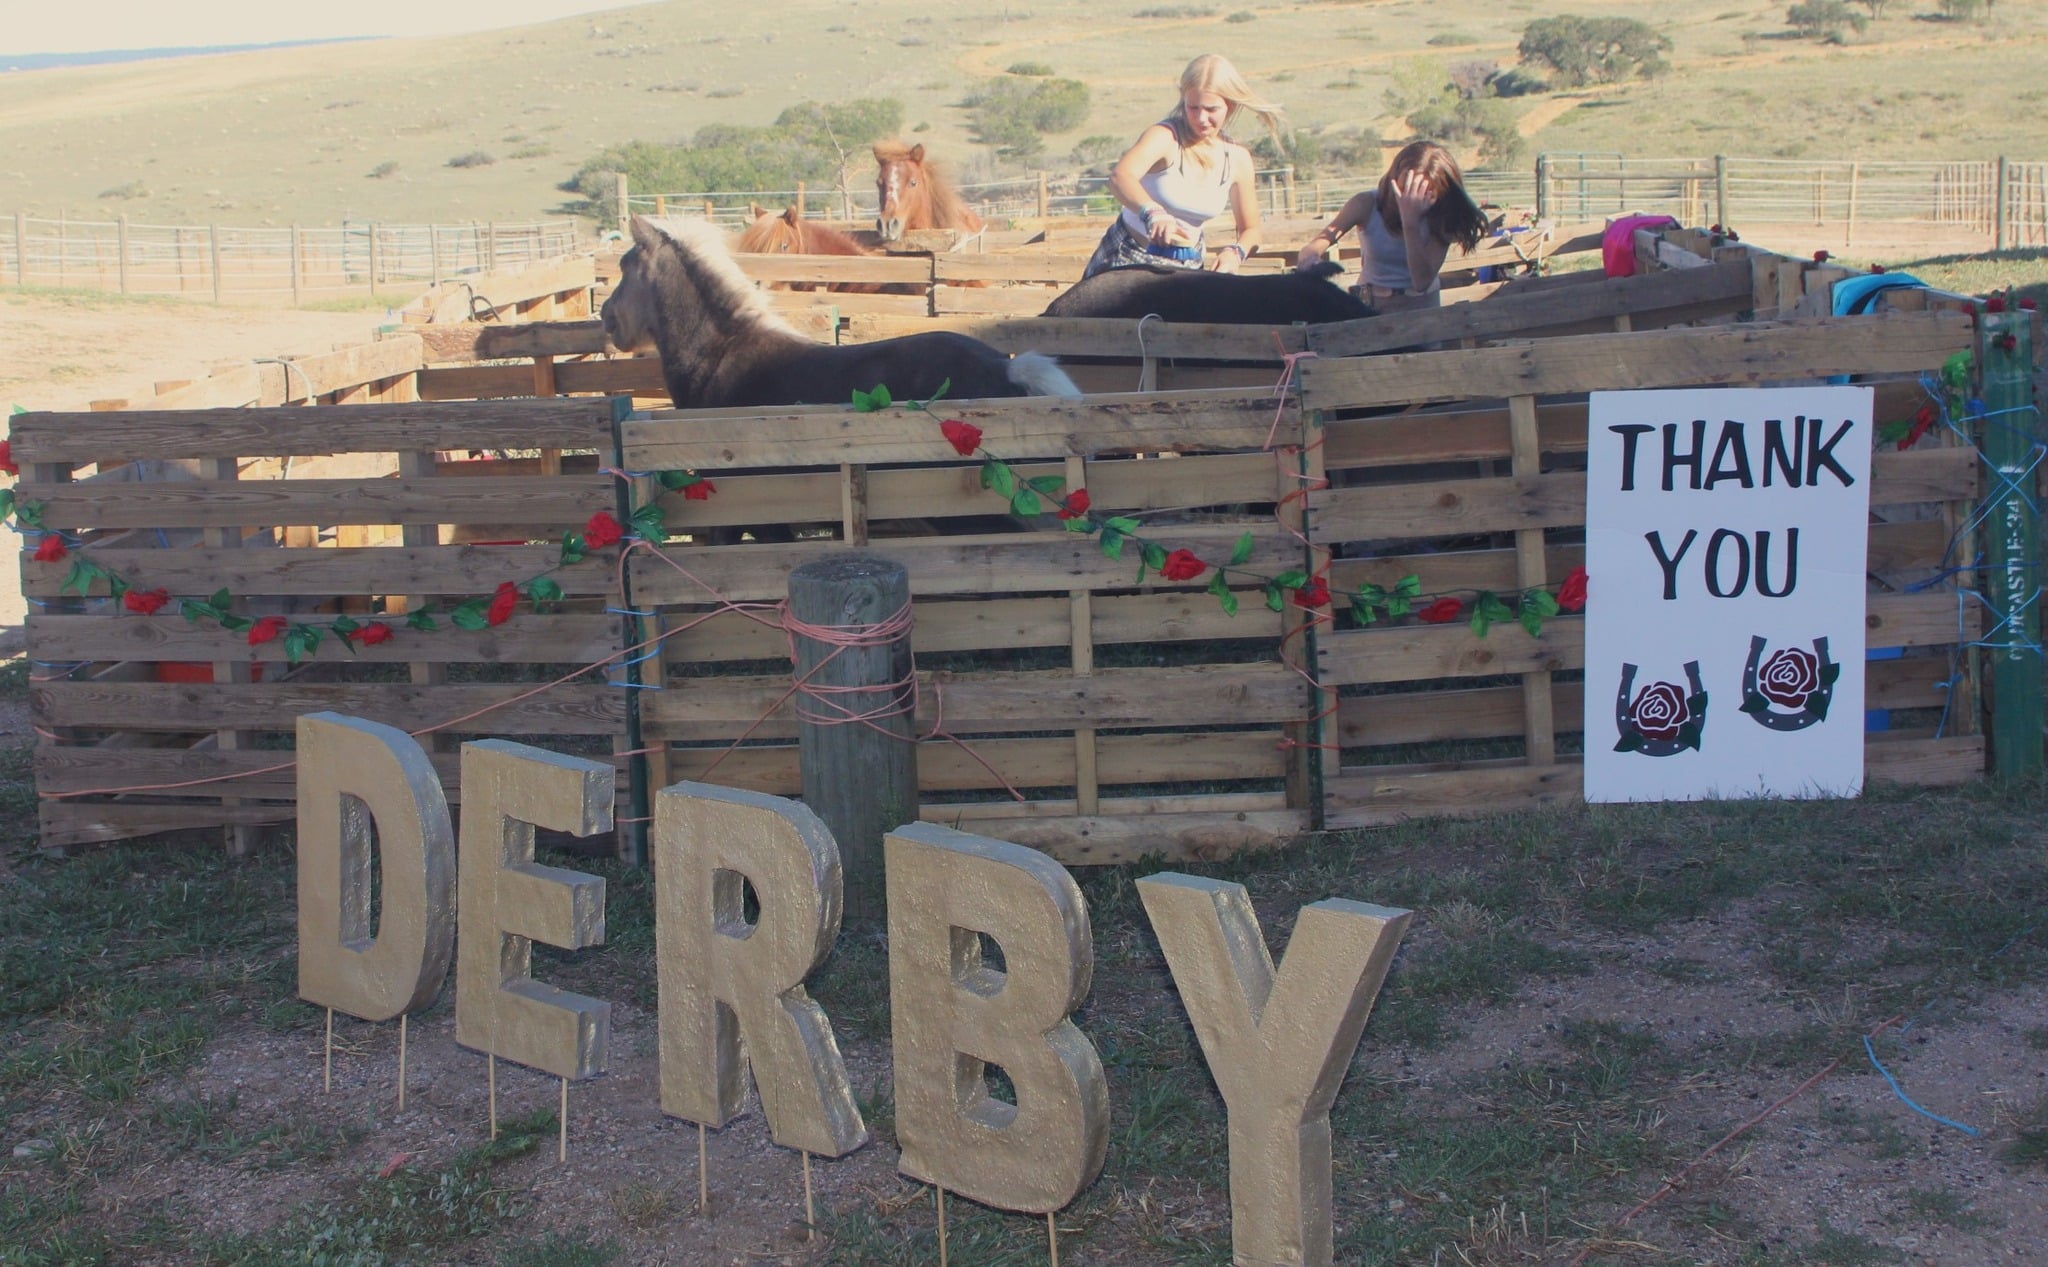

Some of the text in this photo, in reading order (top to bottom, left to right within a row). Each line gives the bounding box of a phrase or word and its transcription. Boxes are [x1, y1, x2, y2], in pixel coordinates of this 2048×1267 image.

[1608, 415, 1855, 491] THANK
[1644, 527, 1799, 600] YOU
[295, 711, 1413, 1267] DERBY
